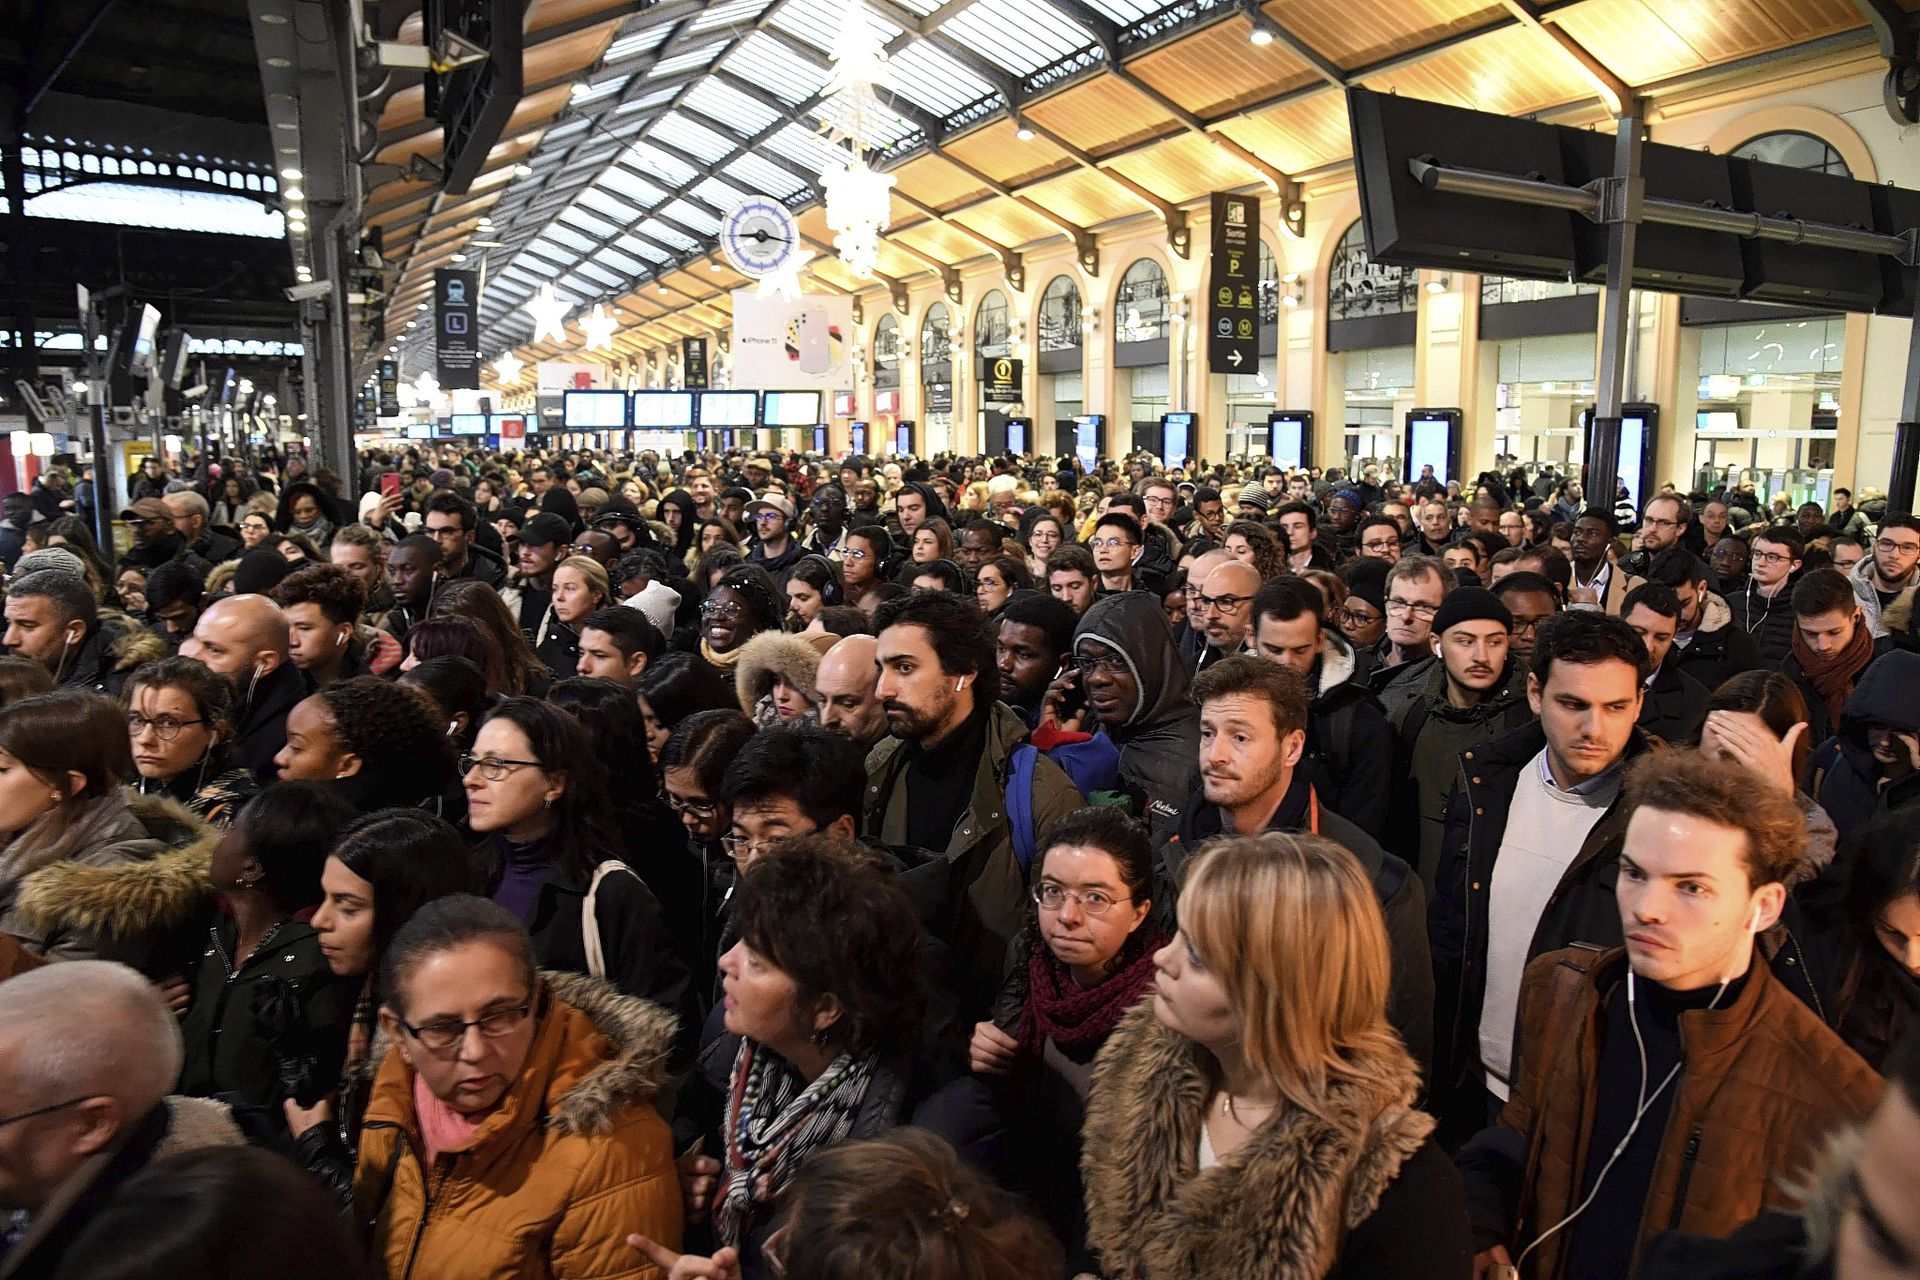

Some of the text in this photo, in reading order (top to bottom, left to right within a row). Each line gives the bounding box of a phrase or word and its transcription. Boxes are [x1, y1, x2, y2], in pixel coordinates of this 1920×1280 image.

[1230, 259, 1240, 273] P
[452, 318, 461, 330] L
[747, 336, 770, 345] iPhone
